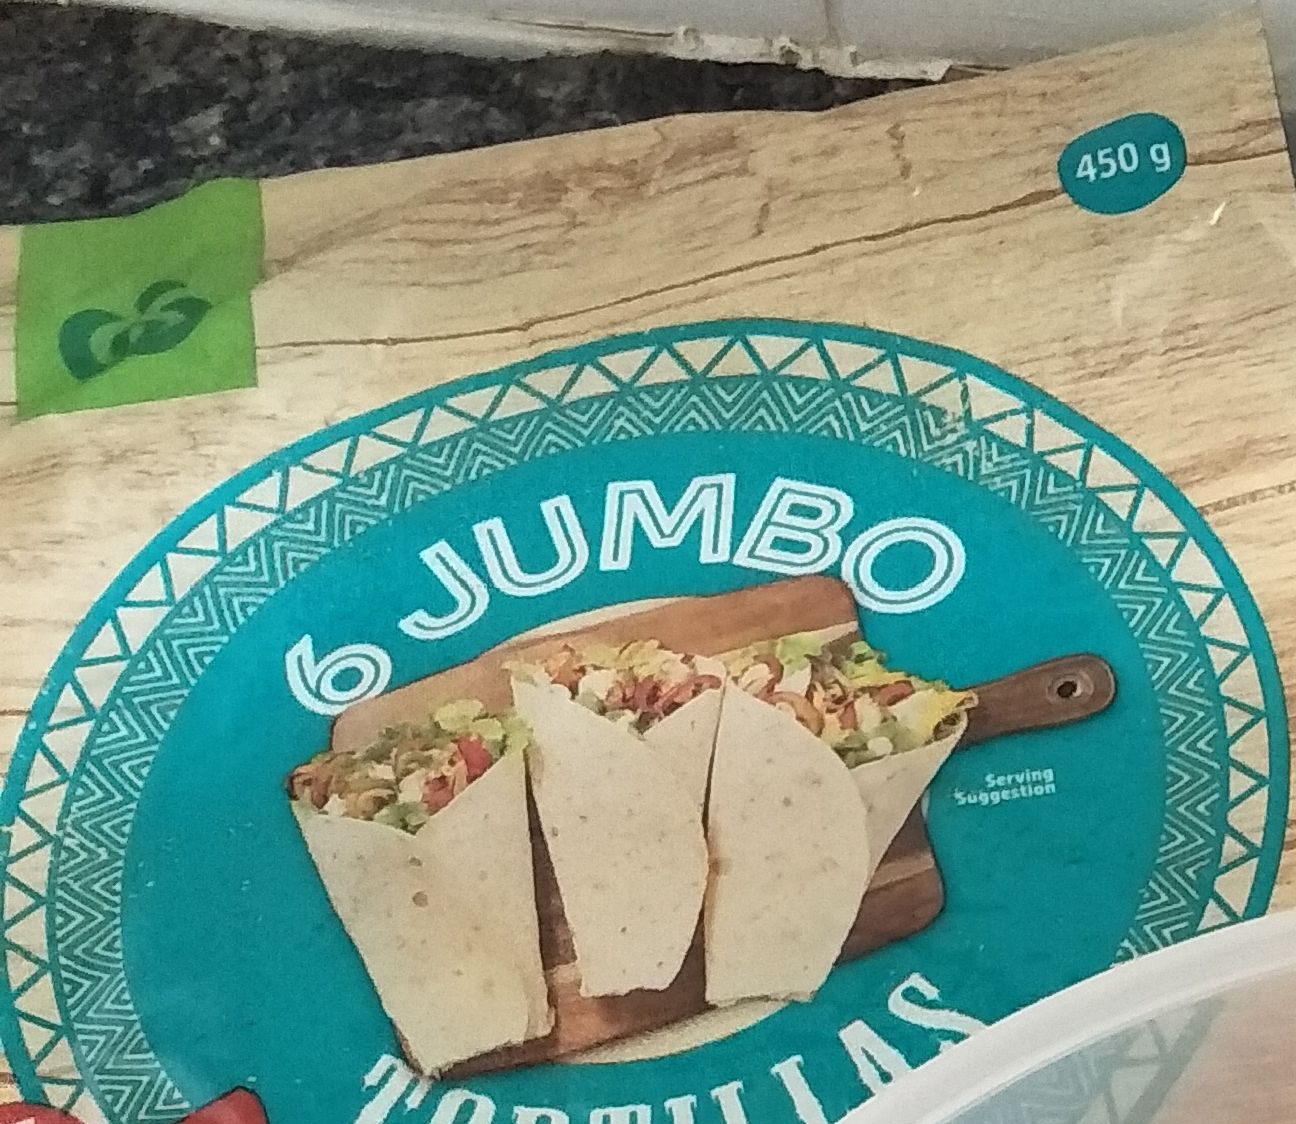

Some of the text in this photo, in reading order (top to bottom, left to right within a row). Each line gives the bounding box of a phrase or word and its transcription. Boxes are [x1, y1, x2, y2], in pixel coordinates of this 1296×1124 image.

[1076, 142, 1171, 182] 450 g
[285, 473, 967, 716] 6 JUMBO
[985, 768, 1054, 788] Serving
[953, 783, 1056, 806] Suggestion
